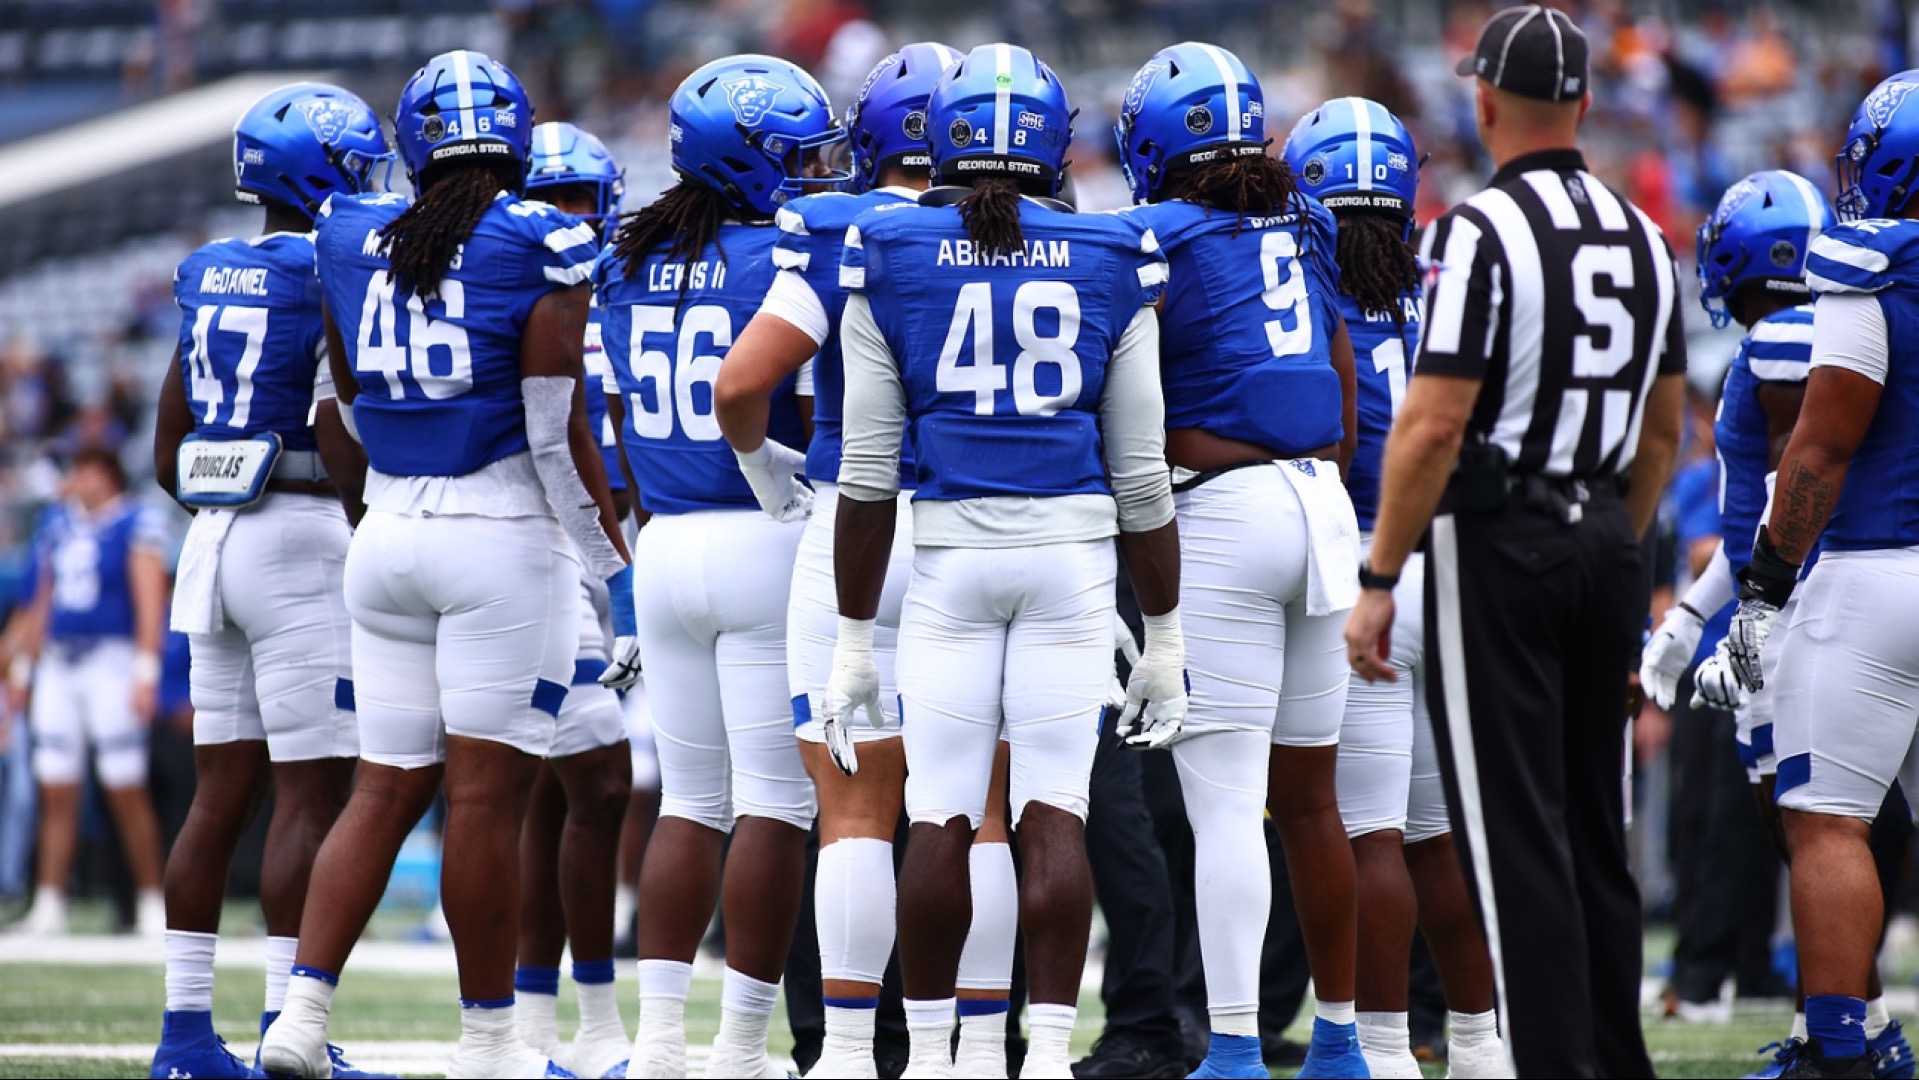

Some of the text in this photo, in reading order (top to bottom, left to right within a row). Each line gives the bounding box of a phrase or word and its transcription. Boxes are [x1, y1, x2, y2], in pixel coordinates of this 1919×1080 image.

[447, 120, 460, 135] 4
[478, 116, 491, 132] 6
[1019, 111, 1044, 130] SBC
[1242, 112, 1252, 128] 9
[974, 127, 988, 144] 4
[1013, 129, 1027, 146] 8
[432, 143, 509, 160] GEORGIA STATE
[957, 160, 1041, 175] GEORGIA STATE
[1344, 163, 1353, 179] 1
[1375, 164, 1387, 180] 0
[1323, 197, 1402, 209] GEORGIA STATE
[936, 239, 1070, 268] ABRAHAM
[649, 261, 708, 293] LEWIS
[1259, 231, 1313, 358] 9
[1571, 245, 1635, 378] S
[357, 268, 474, 401] 46
[935, 280, 1083, 417] 48
[188, 304, 269, 429] 47
[629, 304, 733, 442] 56
[189, 455, 246, 479] DOUGLAS
